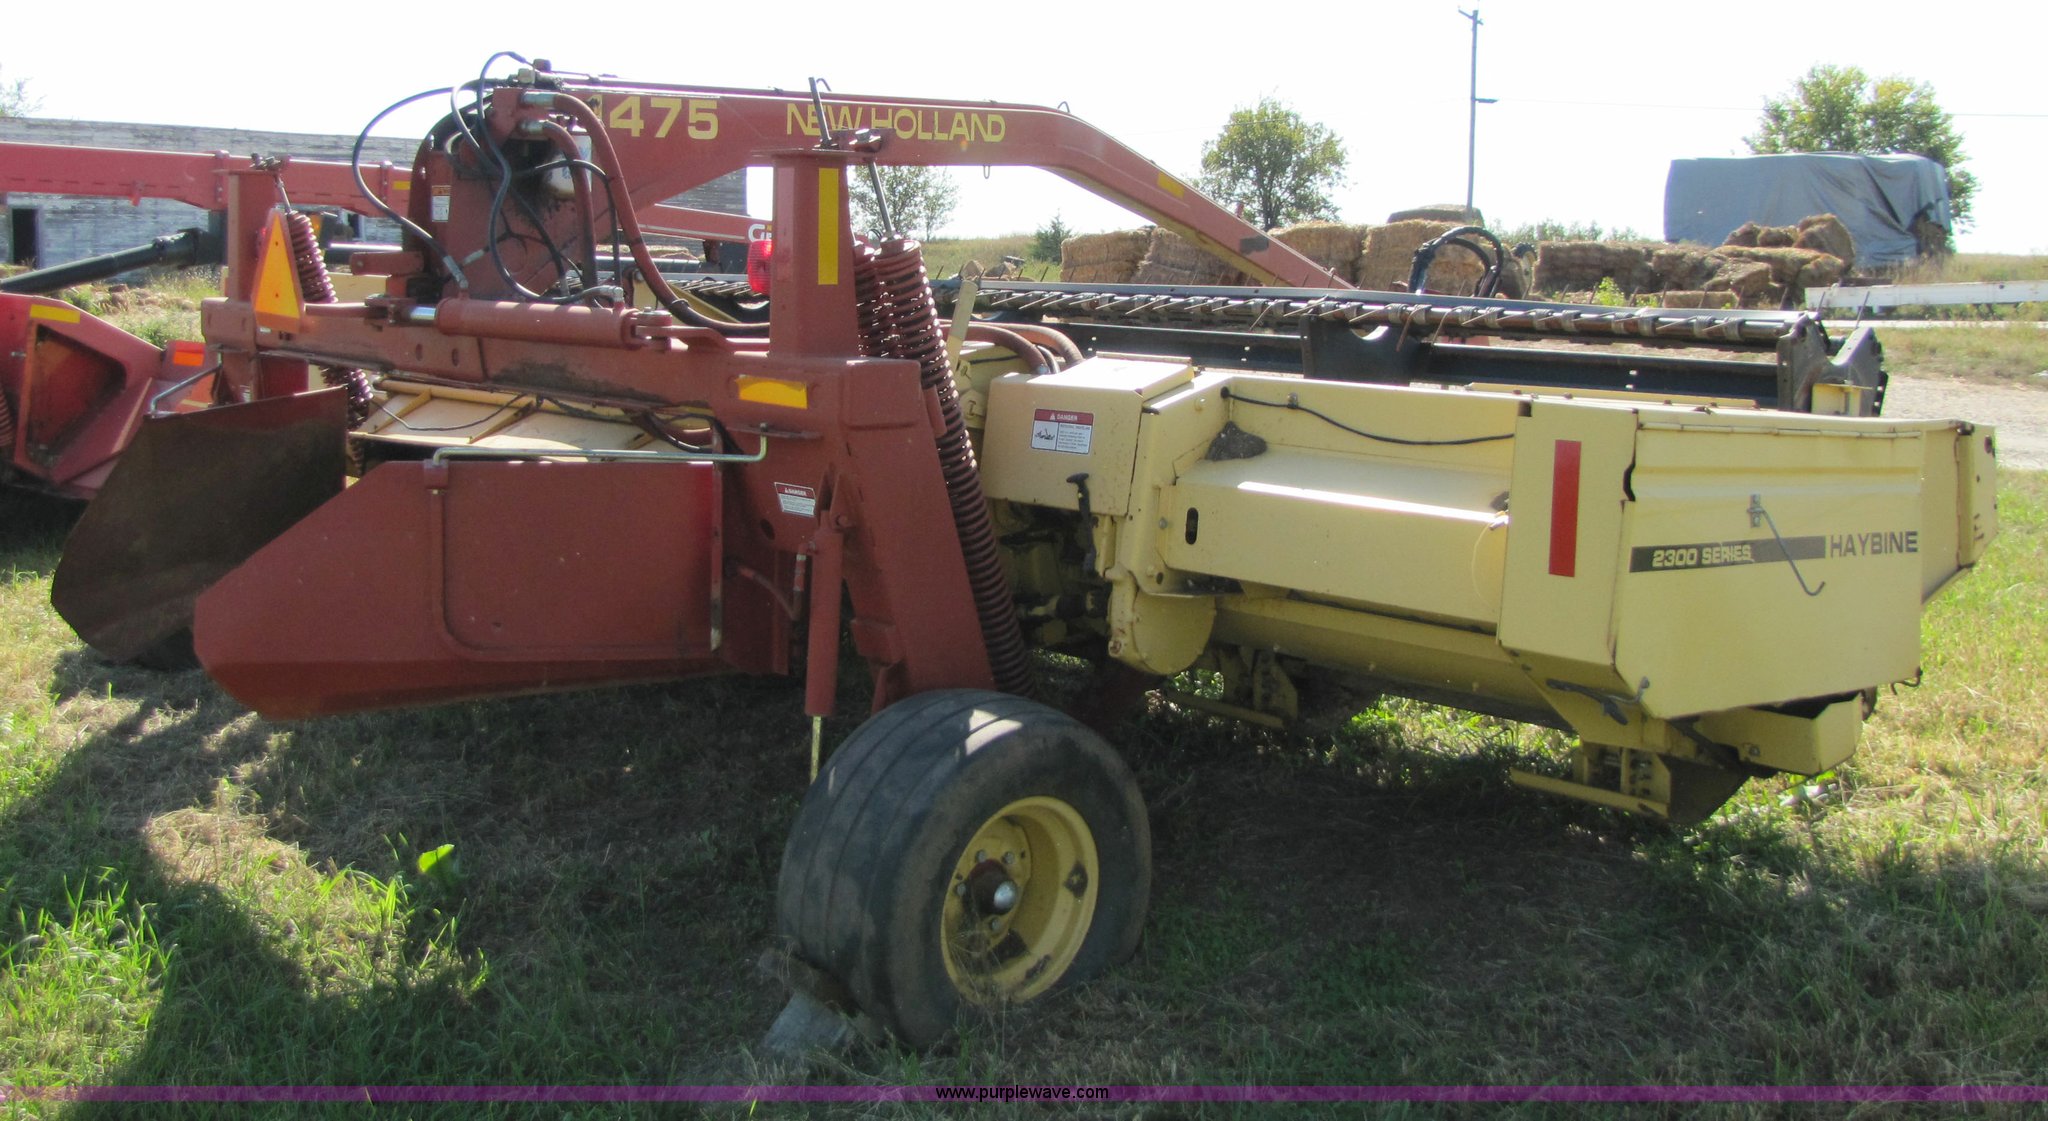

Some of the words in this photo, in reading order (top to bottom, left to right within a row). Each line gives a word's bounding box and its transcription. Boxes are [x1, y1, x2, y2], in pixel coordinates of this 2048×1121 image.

[786, 103, 863, 136] NEW
[870, 108, 1006, 142] HOLLAND
[1652, 549, 1697, 567] 2300
[1701, 545, 1752, 563] SERIES
[1830, 530, 1918, 558] HAYBINE
